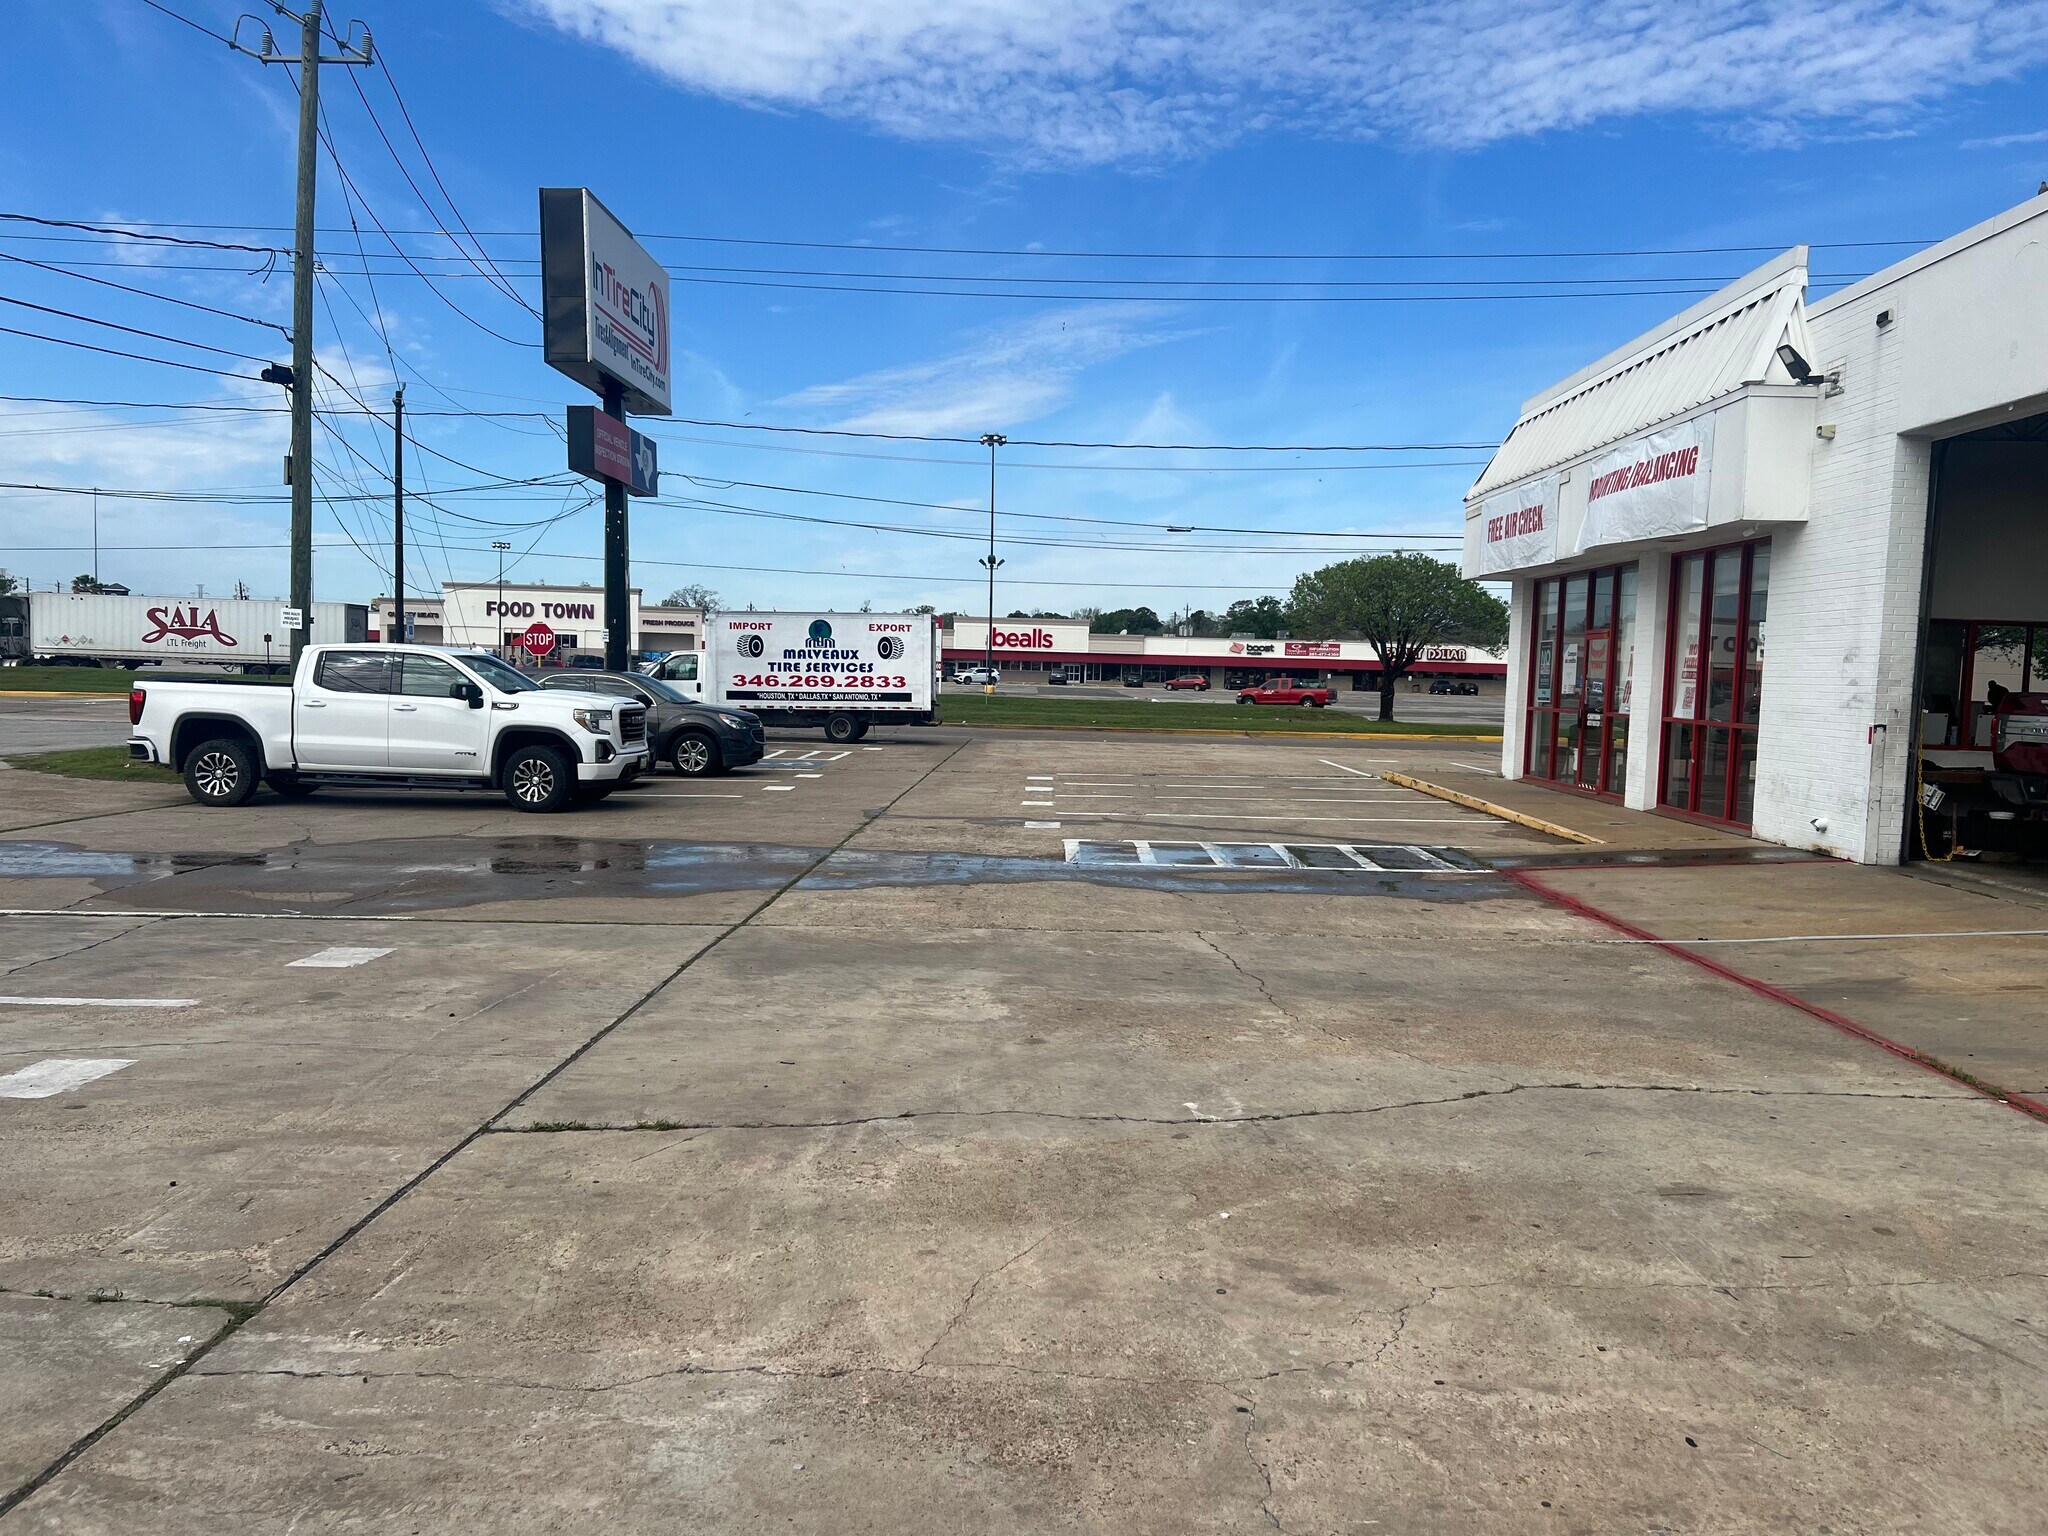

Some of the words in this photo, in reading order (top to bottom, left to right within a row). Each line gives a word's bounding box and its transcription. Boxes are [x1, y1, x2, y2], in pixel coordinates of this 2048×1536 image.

[592, 251, 655, 348] InTireCity
[629, 353, 666, 393] InTireCity.com
[1487, 515, 1504, 544] FREE
[1504, 511, 1518, 540] AIR
[1518, 504, 1544, 536] CHECK
[486, 600, 535, 618] FOOD
[541, 602, 595, 620] TOWN
[142, 605, 238, 647] SAIA
[729, 622, 773, 631] IMPORT
[868, 623, 913, 633] EXPORT
[166, 638, 179, 647] LTL
[181, 639, 207, 650] Freight
[525, 633, 553, 646] STOP
[992, 627, 1054, 649] bealls
[783, 648, 860, 660] MALVEAUX
[1246, 643, 1275, 653] boost
[1426, 648, 1467, 661] DOLLAR
[767, 661, 801, 673] TIRE
[805, 661, 874, 674] SERVICES
[732, 674, 907, 688] 346.269.2833
[832, 693, 844, 701] SAN
